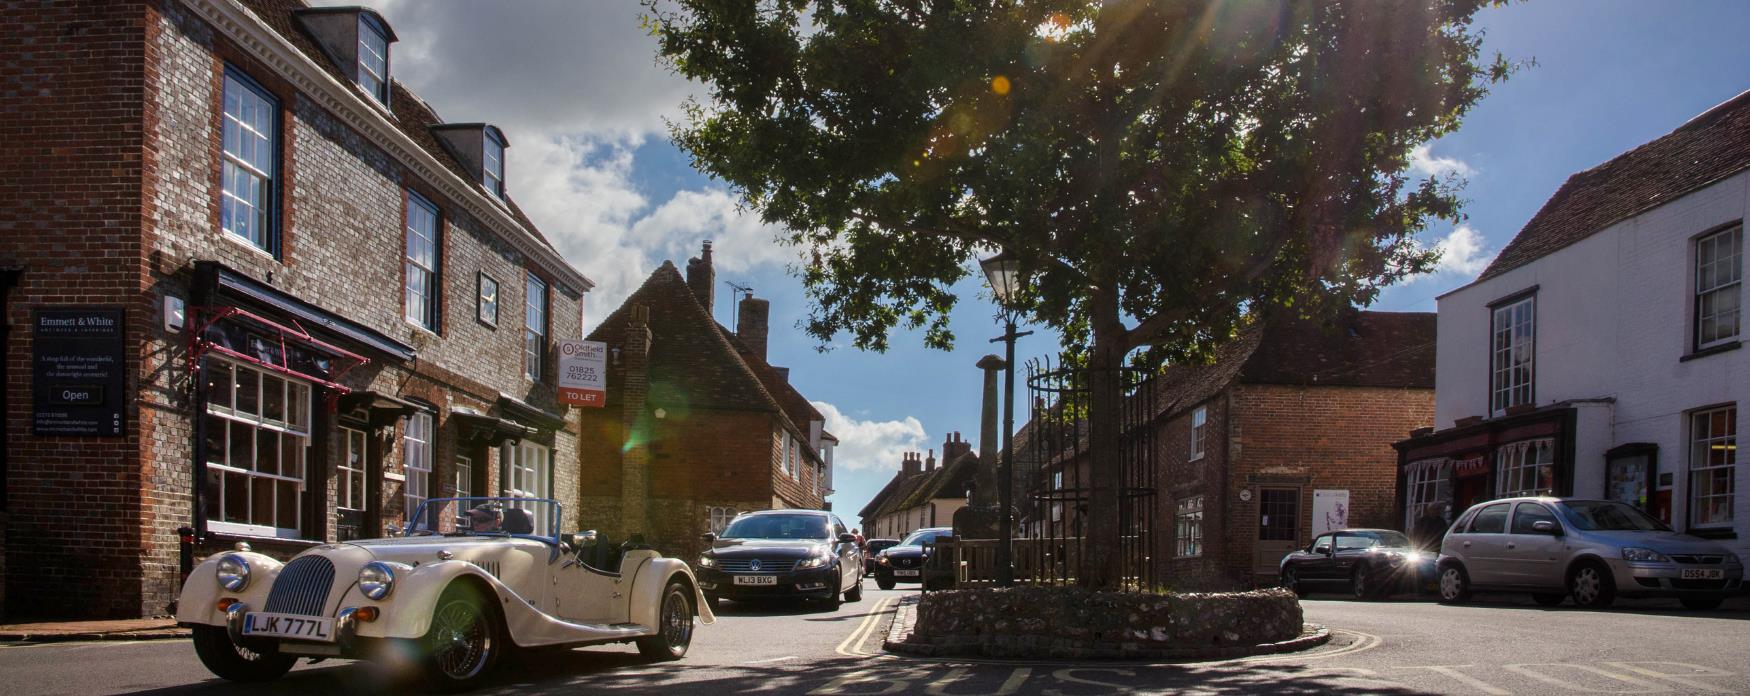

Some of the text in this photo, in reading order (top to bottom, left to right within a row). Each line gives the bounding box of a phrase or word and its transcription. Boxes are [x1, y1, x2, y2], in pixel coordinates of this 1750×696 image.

[40, 317, 114, 326] Emmett & White
[574, 343, 604, 353] Oldfield
[574, 350, 596, 358] Smith
[569, 365, 595, 375] 01825
[566, 372, 598, 382] 762222
[62, 390, 89, 402] Open
[566, 392, 597, 401] TO LET
[757, 576, 772, 584] BXG
[252, 616, 327, 637] LJK 777L
